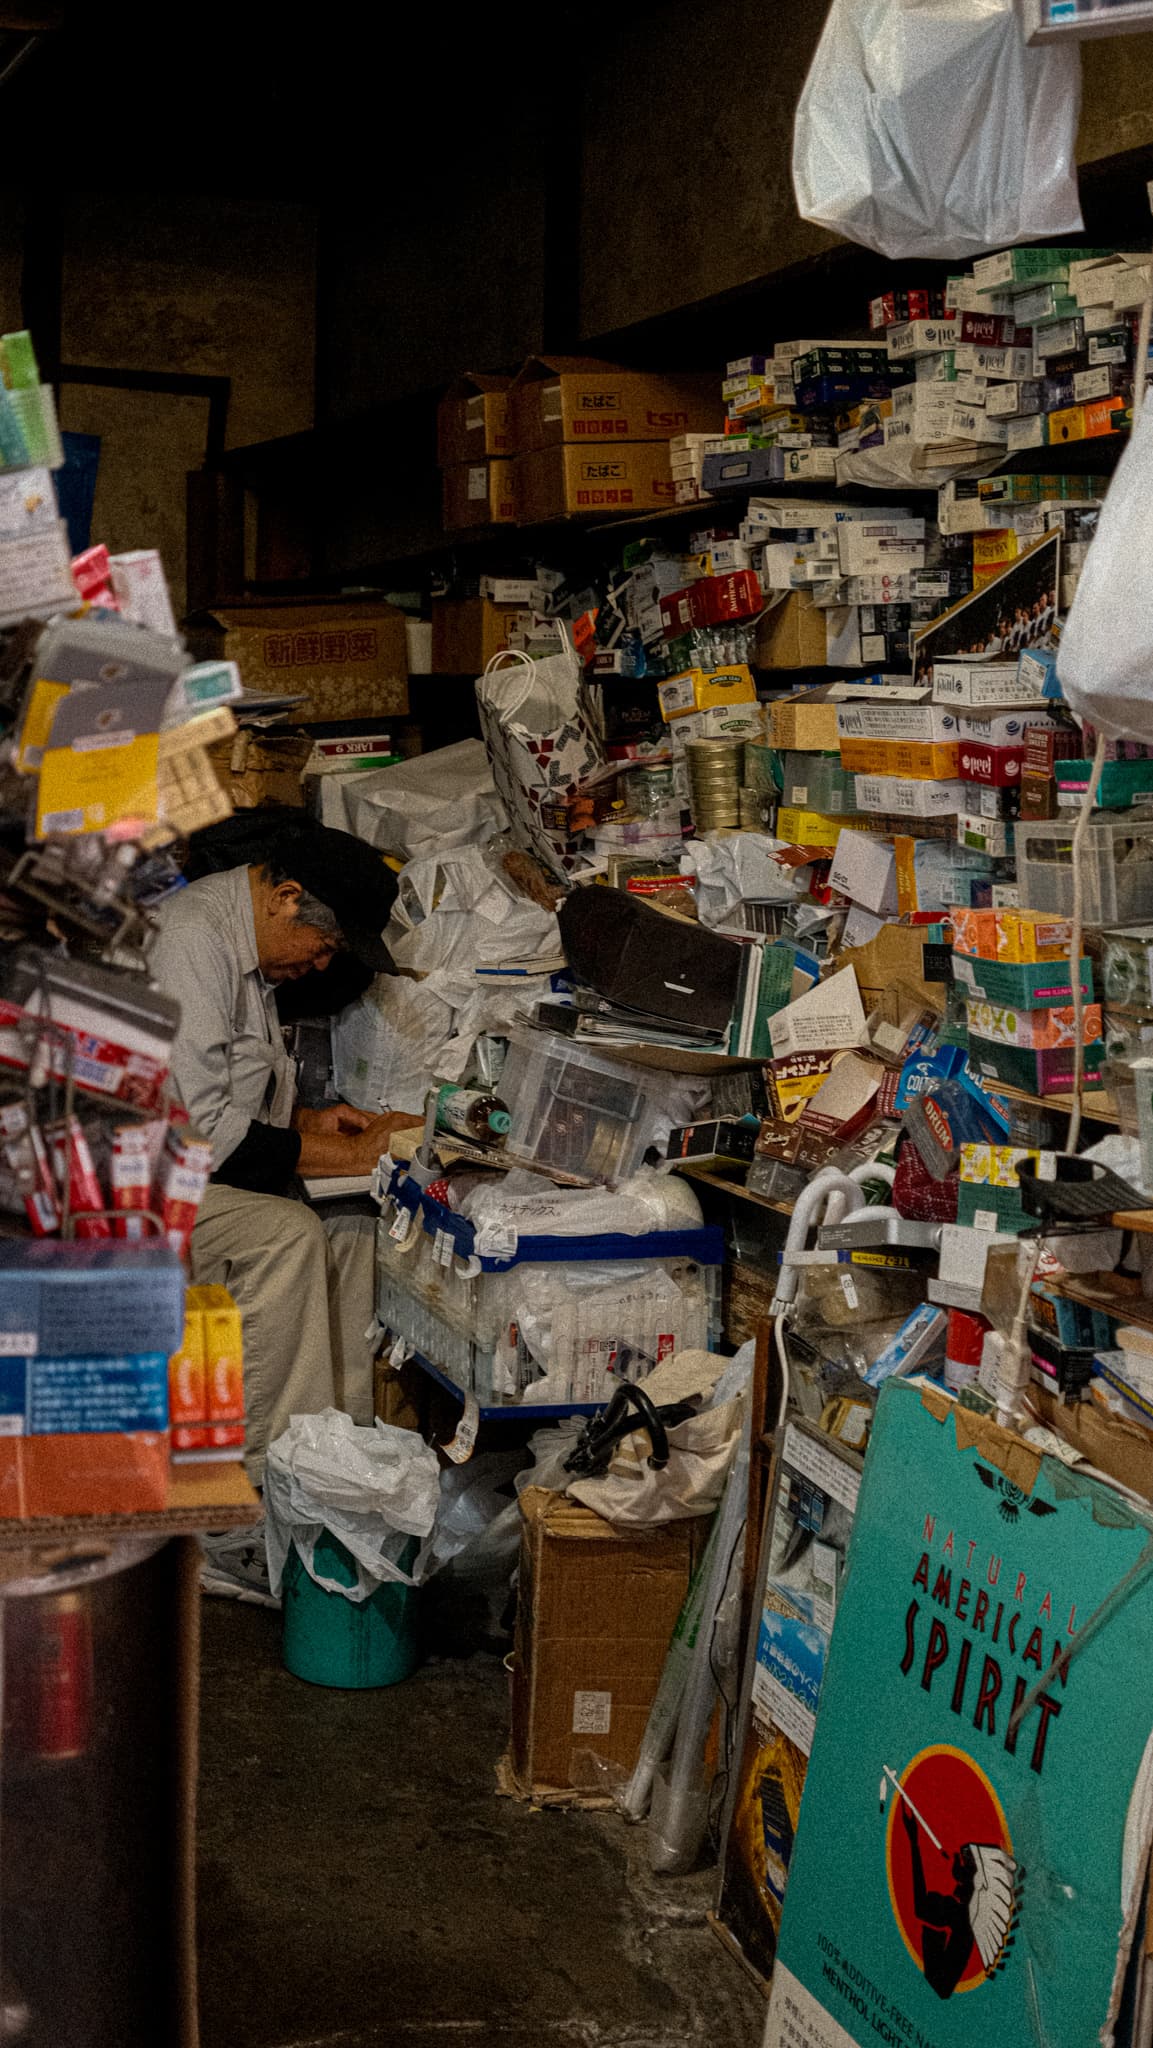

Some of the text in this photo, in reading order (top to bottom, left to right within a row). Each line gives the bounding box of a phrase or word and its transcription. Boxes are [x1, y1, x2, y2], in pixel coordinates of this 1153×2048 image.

[582, 395, 617, 409] たばこ
[586, 464, 622, 478] たばこ
[265, 629, 378, 668] 新鮮野菜
[924, 1101, 952, 1148] DRUM
[923, 1512, 1080, 1636] NATURAL
[911, 1551, 1074, 1690] AMERICAN
[900, 1598, 1064, 1776] SPIRIT
[822, 1961, 870, 2022] MENTHOL
